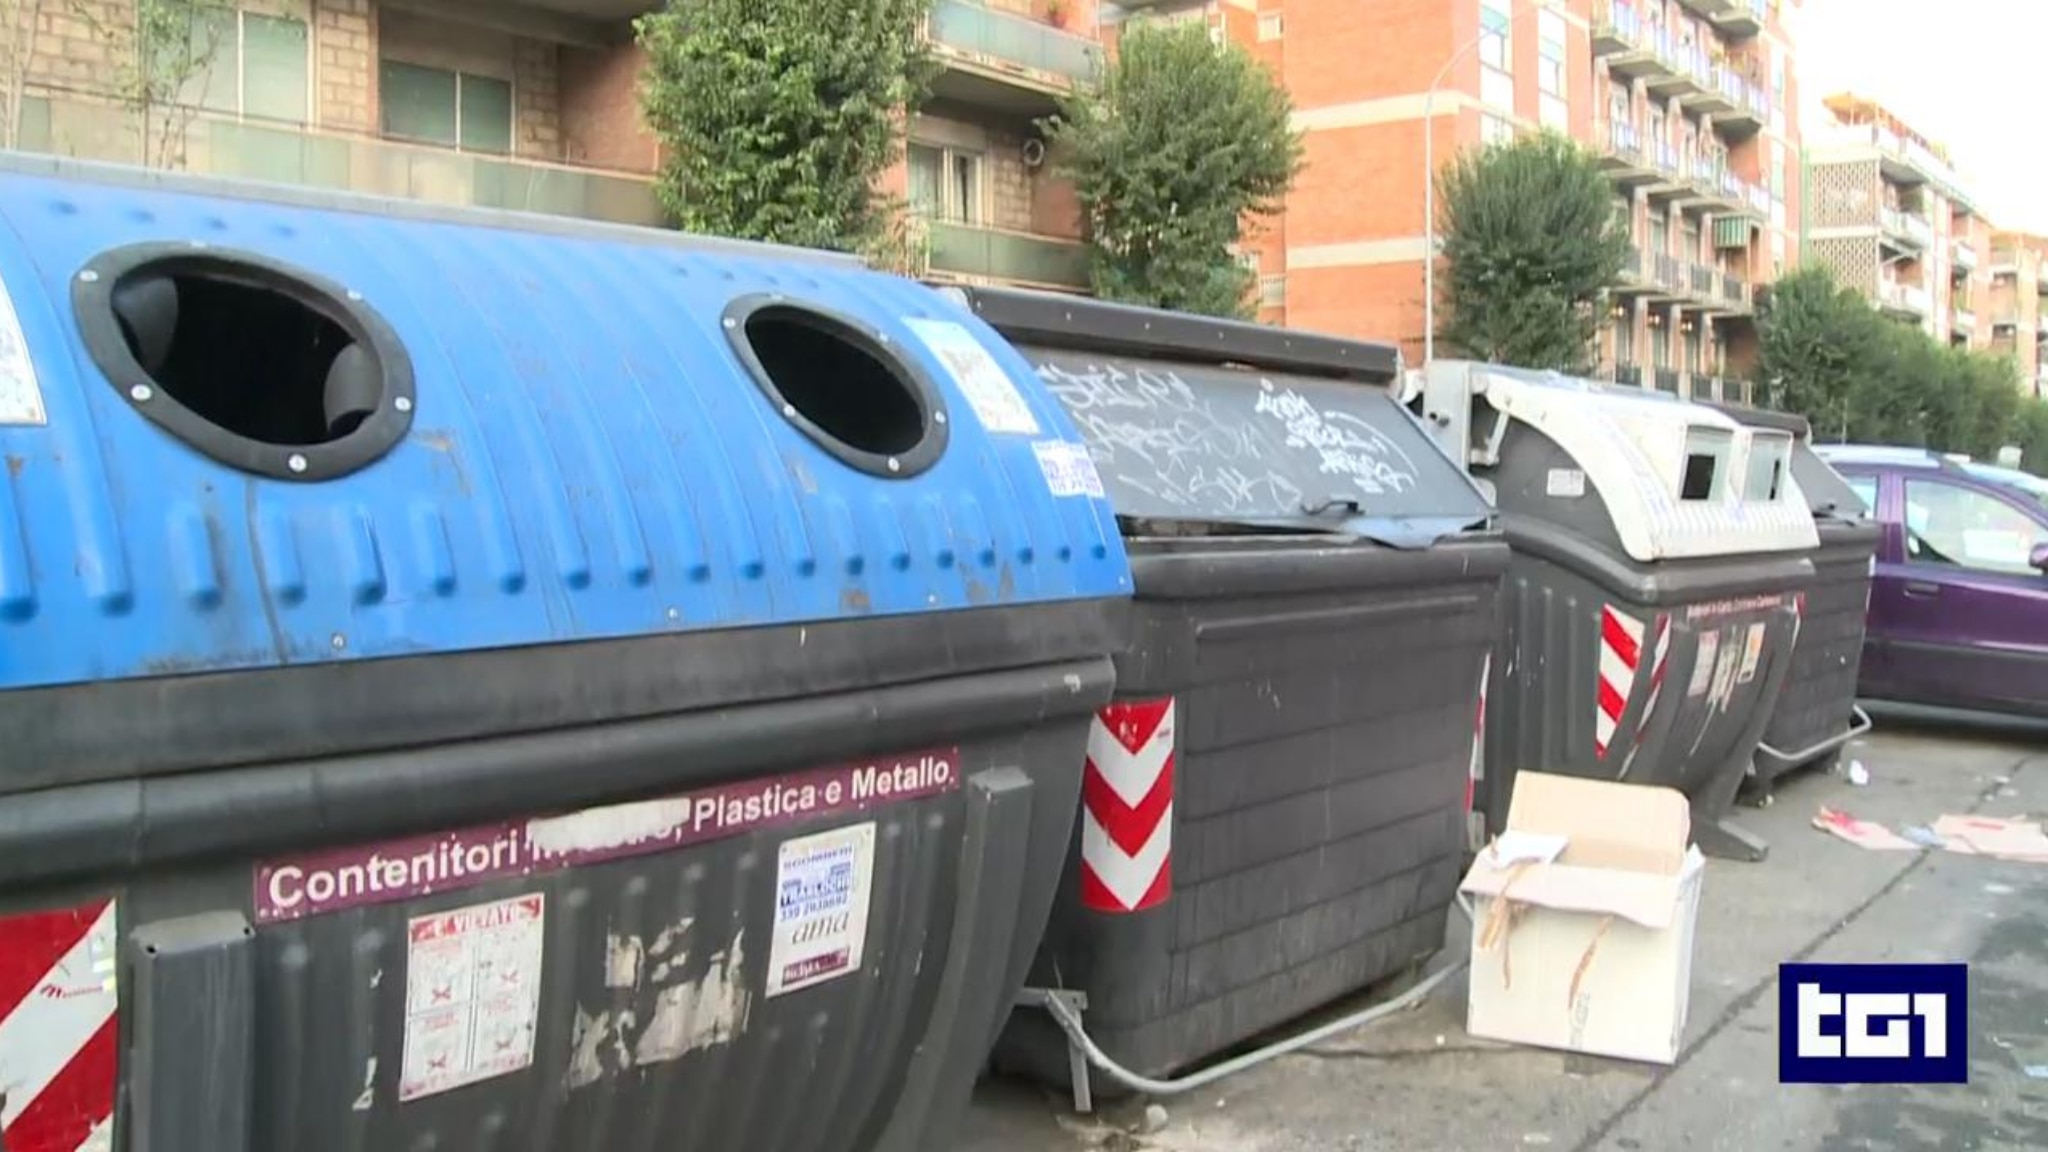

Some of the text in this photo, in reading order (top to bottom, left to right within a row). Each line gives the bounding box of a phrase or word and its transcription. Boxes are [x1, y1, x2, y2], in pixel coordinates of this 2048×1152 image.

[268, 829, 518, 908] Contenitori
[694, 784, 816, 832] Plastica
[825, 780, 842, 804] e
[791, 911, 850, 945] ama
